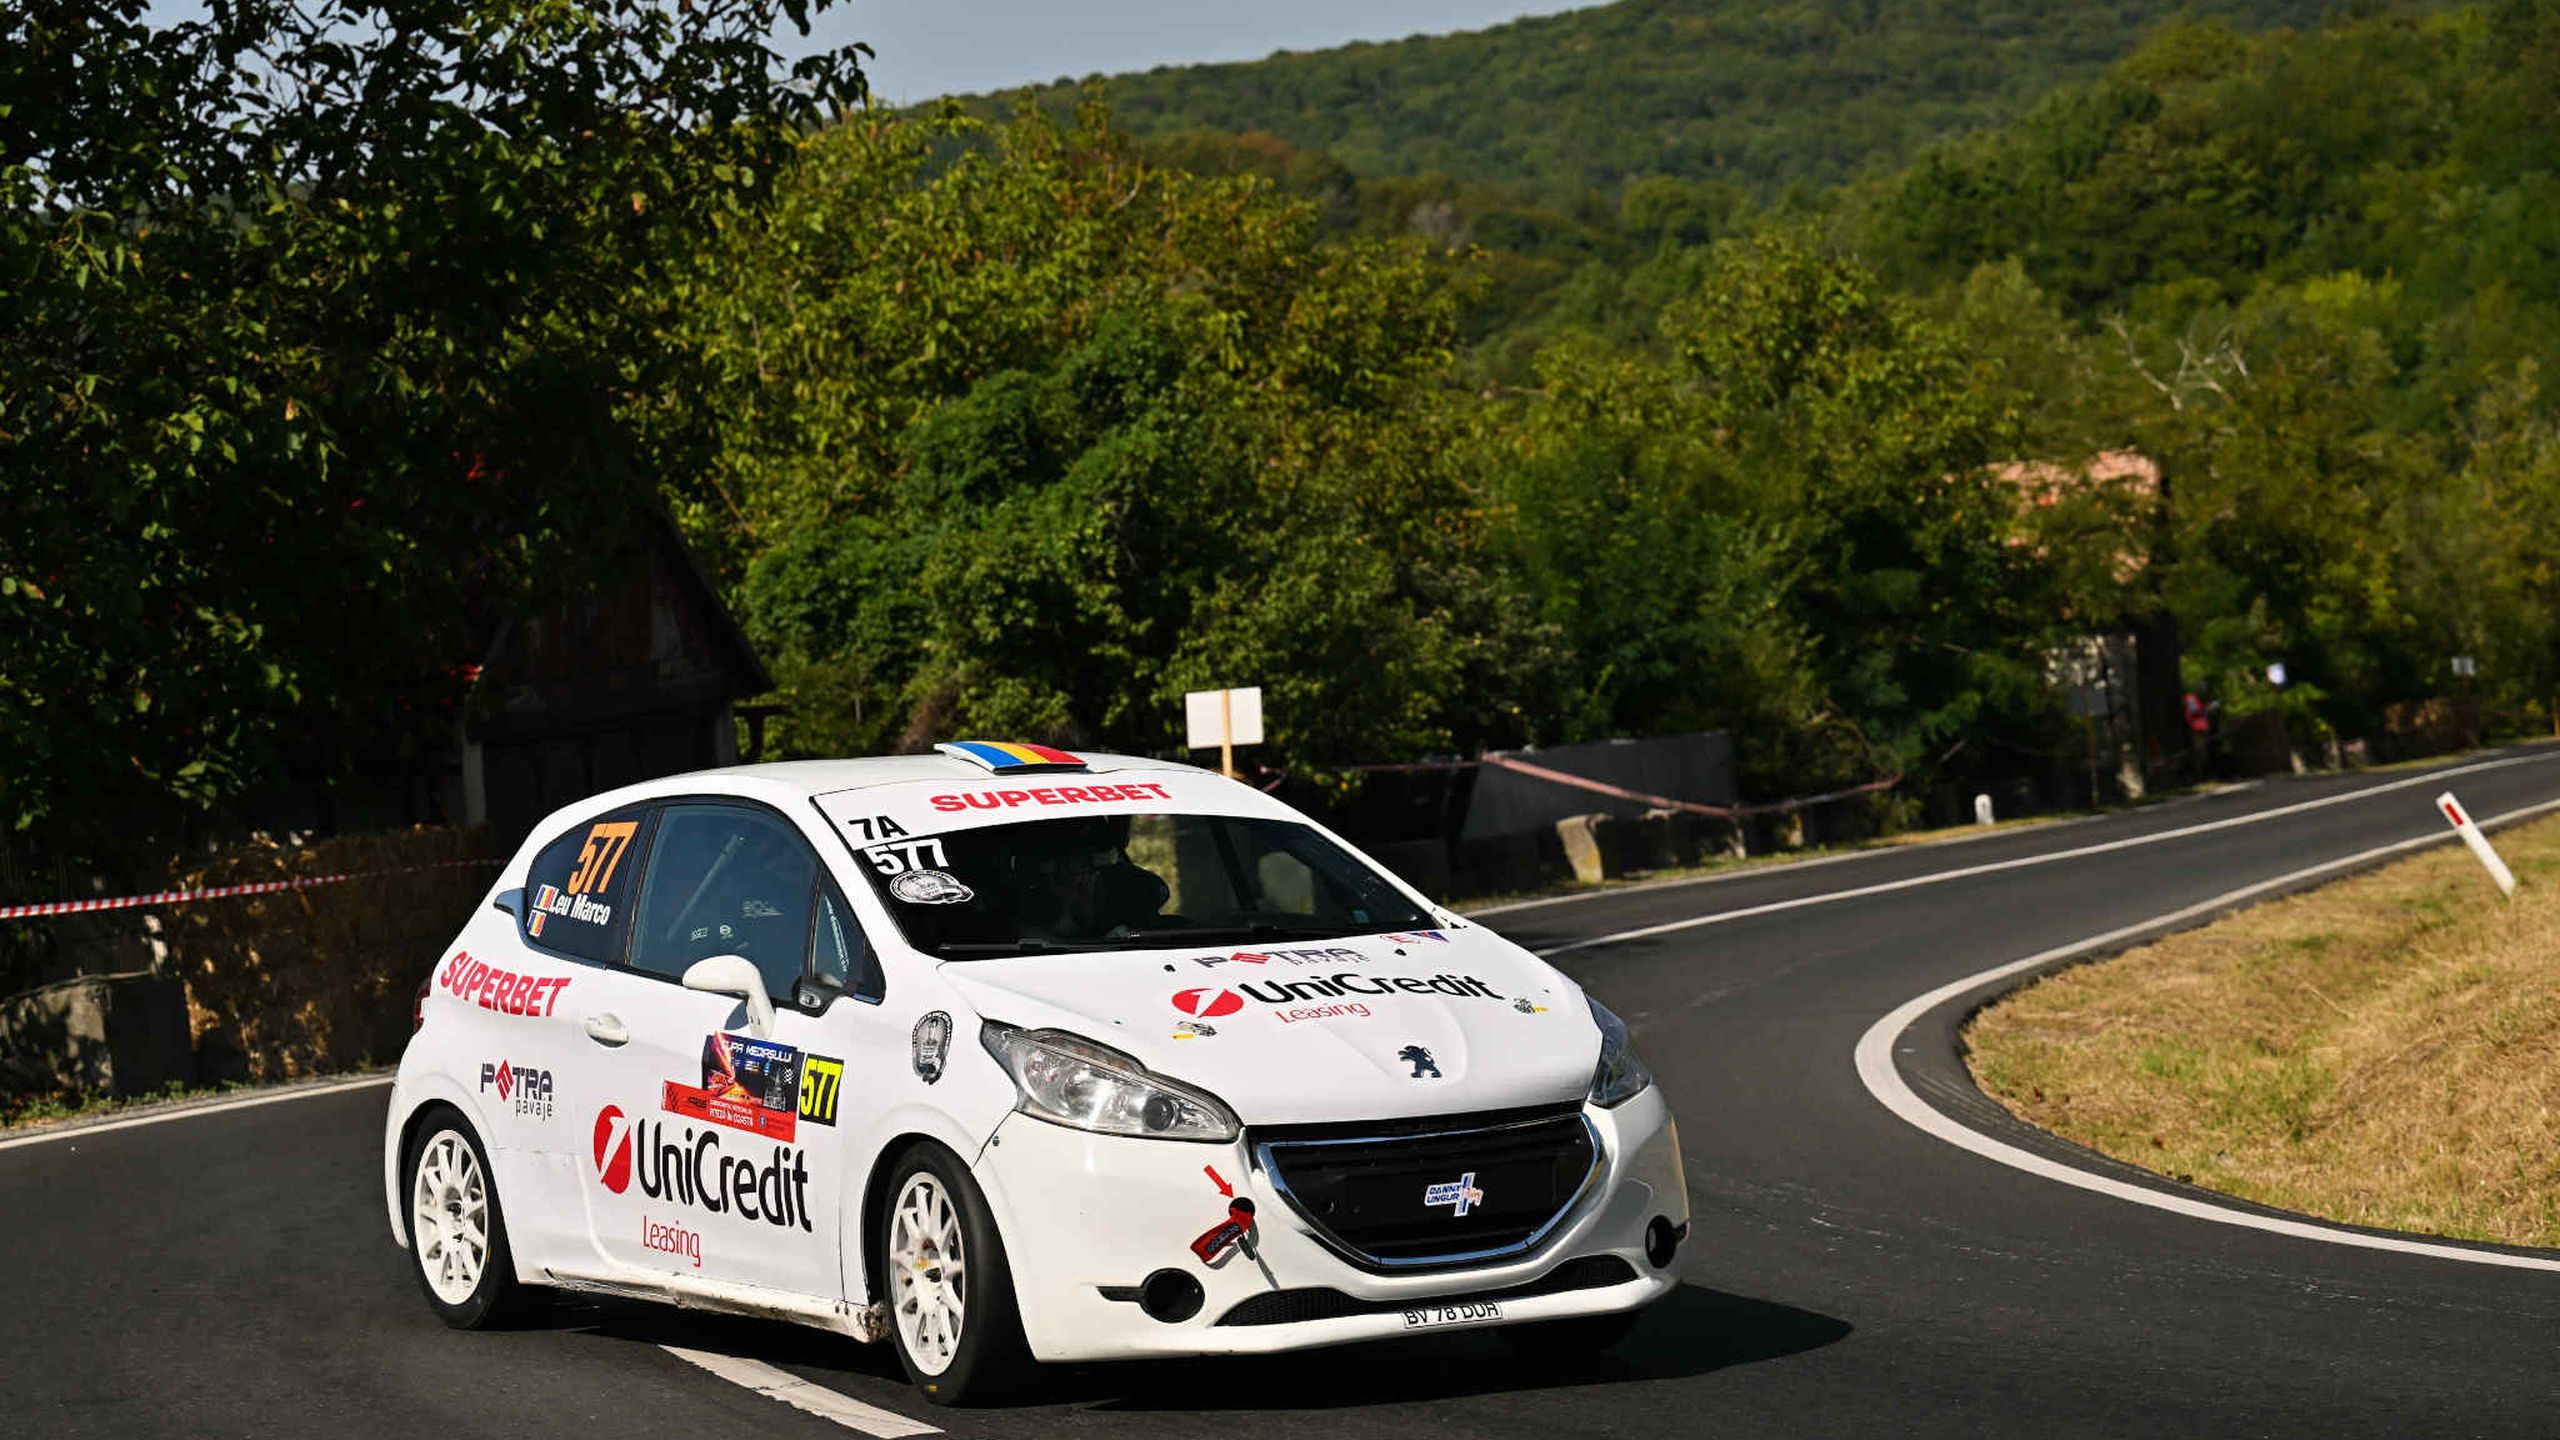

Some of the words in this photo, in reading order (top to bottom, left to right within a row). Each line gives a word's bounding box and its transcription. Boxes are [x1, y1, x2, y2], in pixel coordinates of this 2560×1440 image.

[930, 784, 1173, 812] SUPERBET
[848, 815, 909, 840] 7A
[568, 821, 639, 895] 577
[864, 838, 949, 875] 577
[549, 889, 572, 916] Leu
[570, 894, 611, 926] Marco
[441, 951, 572, 1017] SUPERBET
[1239, 973, 1505, 1004] UniCredit
[1275, 1001, 1371, 1024] Leasing
[801, 1057, 843, 1120] 577
[515, 1100, 552, 1121] pavaje
[638, 1118, 813, 1233] UniCredit
[643, 1215, 701, 1268] Leasing
[1405, 1309, 1428, 1325] BV
